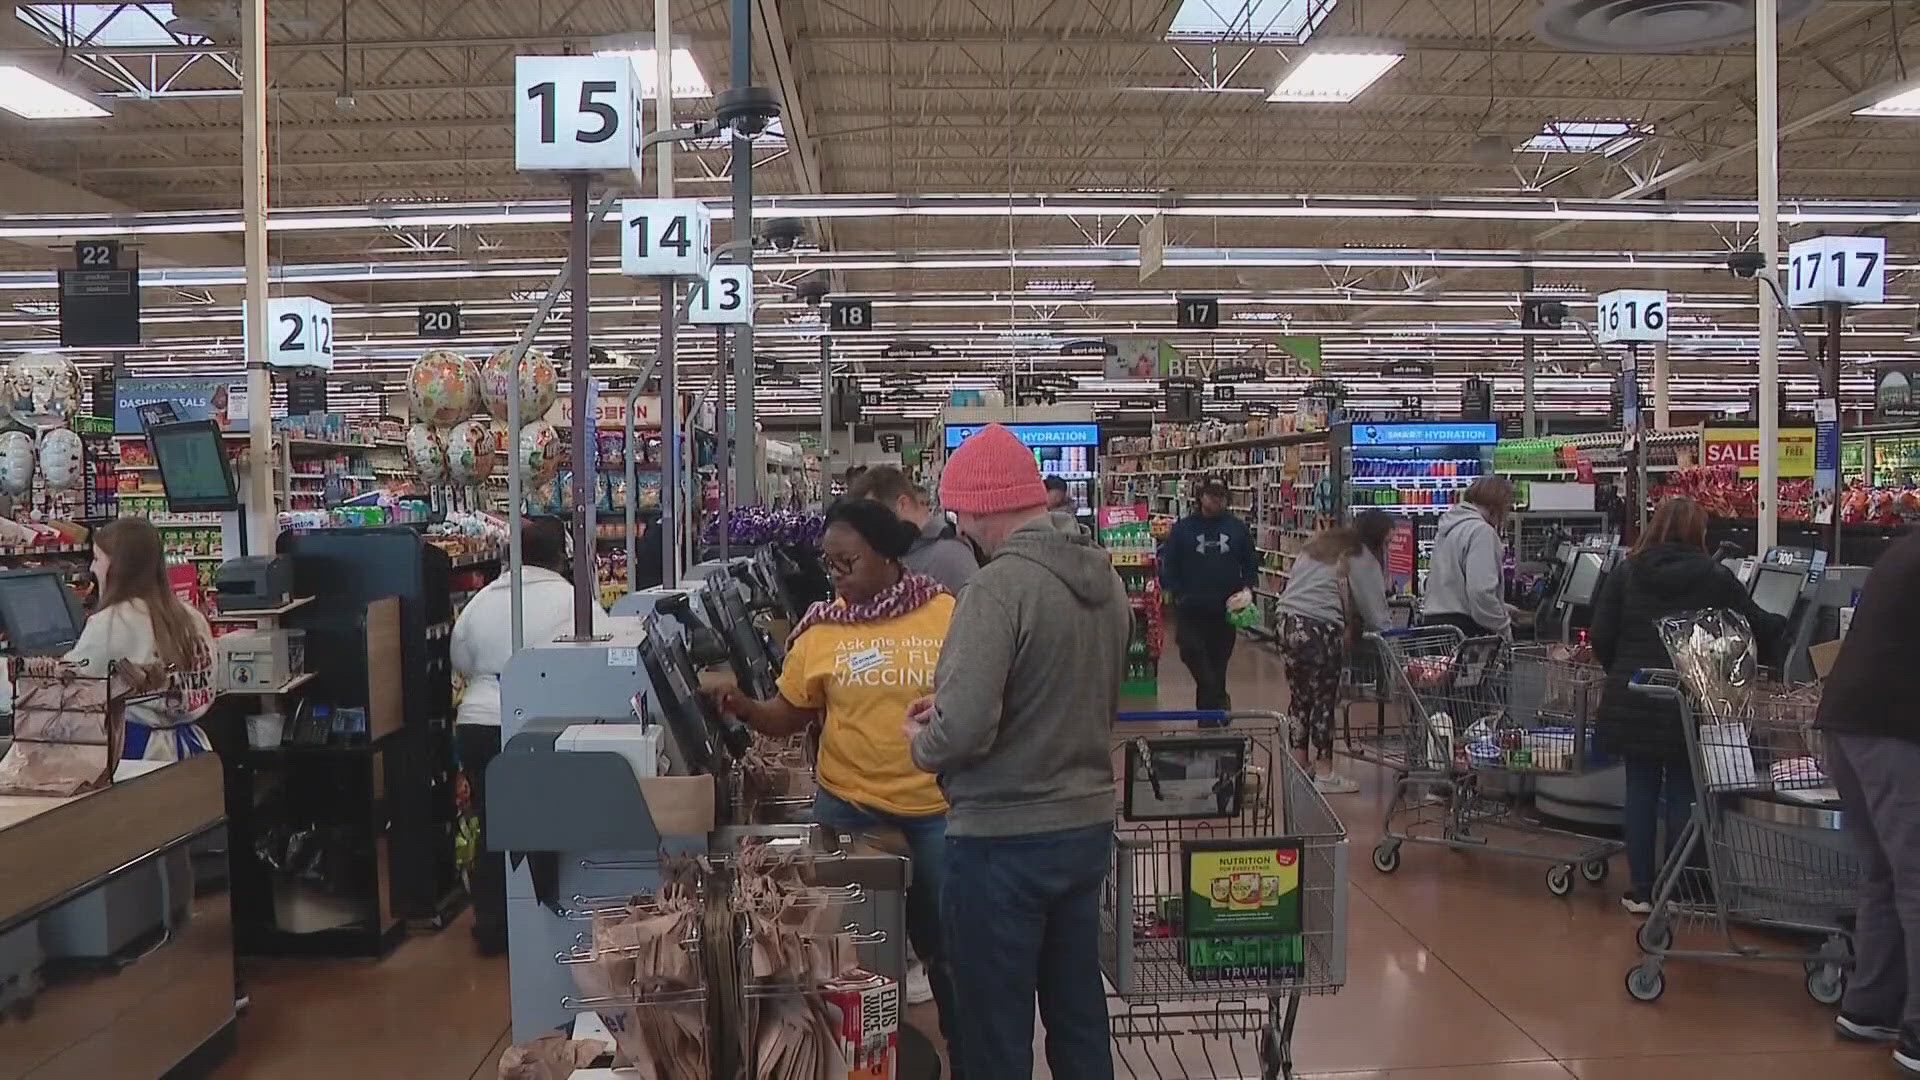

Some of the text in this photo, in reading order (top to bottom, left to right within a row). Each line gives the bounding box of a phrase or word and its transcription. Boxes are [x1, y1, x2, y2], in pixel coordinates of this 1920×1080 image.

[527, 80, 618, 144] 15
[629, 215, 691, 258] 14
[82, 246, 110, 265] 22
[1792, 252, 1822, 291] 17
[1831, 251, 1879, 287] 17
[424, 311, 452, 331] 20
[839, 306, 864, 326] 18
[1187, 303, 1209, 323] 17
[1600, 302, 1620, 332] 16
[1625, 301, 1664, 330] 16
[279, 312, 305, 352] 2
[311, 314, 331, 355] 12
[1169, 358, 1312, 378] BEVERAGES
[1406, 396, 1419, 407] 12
[1022, 430, 1087, 442] HYDRATION
[1387, 429, 1486, 441] SMART HYDRATION
[1707, 443, 1759, 462] SALE
[835, 634, 944, 652] Ask me abou
[1219, 856, 1271, 866] NUTRITION
[1224, 966, 1269, 978] TRUTH
[881, 988, 897, 1028] ELVIS
